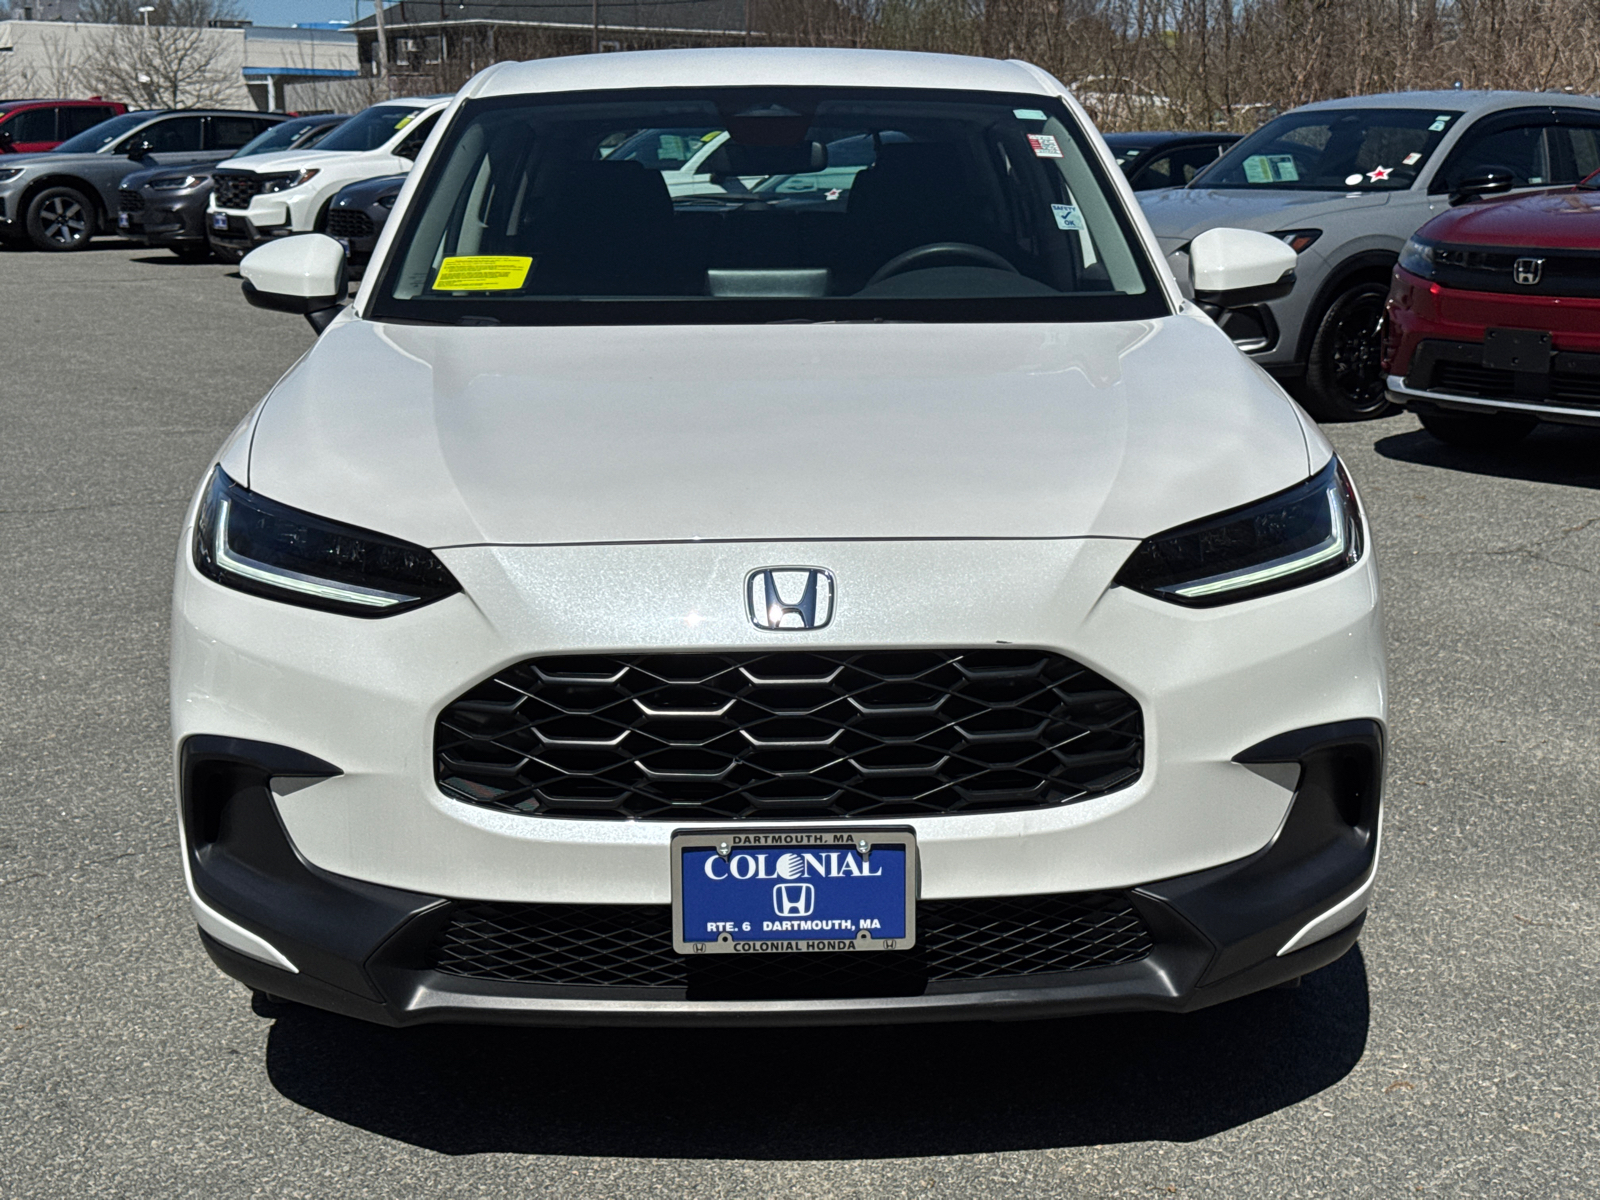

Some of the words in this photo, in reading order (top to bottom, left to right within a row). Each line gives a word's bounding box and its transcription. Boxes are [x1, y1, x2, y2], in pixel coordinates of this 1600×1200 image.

[732, 835, 829, 845] DARTMOUTH,
[833, 834, 854, 843] MA
[704, 852, 882, 880] COLONIAL
[706, 922, 738, 932] RTE.
[742, 922, 751, 931] 6
[763, 920, 856, 931] DARTMOUTH,
[859, 919, 881, 929] MA
[733, 942, 802, 952] COLONIAL
[806, 940, 856, 950] HONDA
